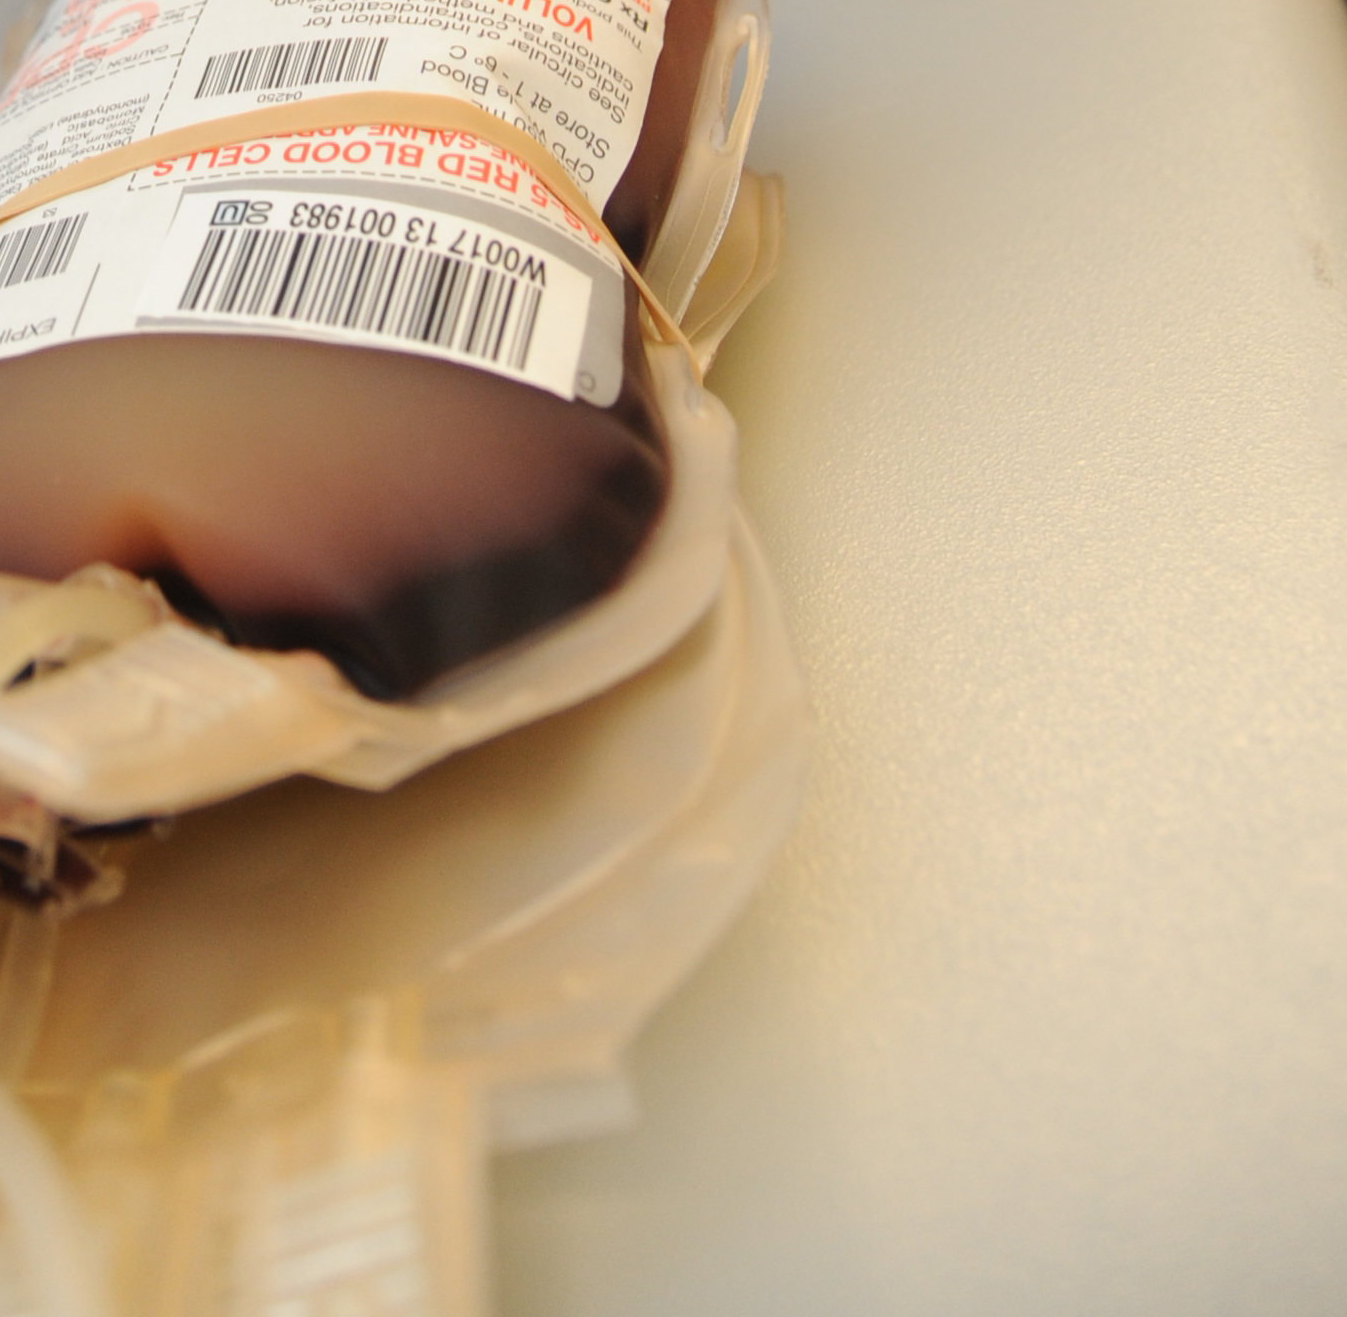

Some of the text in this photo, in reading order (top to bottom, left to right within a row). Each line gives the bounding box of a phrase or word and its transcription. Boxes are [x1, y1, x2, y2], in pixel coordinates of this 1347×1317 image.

[502, 13, 544, 34] and
[620, 2, 649, 33] Rx
[448, 44, 467, 60] C
[616, 22, 643, 54] This
[107, 44, 169, 67] CAUTION
[308, 0, 630, 108] indications, contraindications,
[552, 31, 634, 92] cautions
[302, 14, 625, 124] See circular of information for
[420, 59, 489, 96] Blood
[57, 93, 150, 127] (monohydrate)
[256, 90, 303, 104] 04250
[529, 91, 552, 114] at
[66, 105, 145, 133] Monobasic
[105, 114, 140, 131] Citric
[61, 130, 92, 145] Acid
[71, 135, 132, 159] Dextrose
[86, 124, 137, 146] Sodium
[555, 111, 610, 159] Store
[37, 144, 79, 163] Citrate
[152, 144, 271, 177] CELLS
[283, 141, 424, 169] BLOOD
[551, 141, 595, 184] CPD
[437, 153, 519, 194] RED
[42, 207, 58, 219] 53
[290, 202, 396, 238] 001983
[404, 217, 438, 246] 13
[448, 229, 546, 287] W0017
